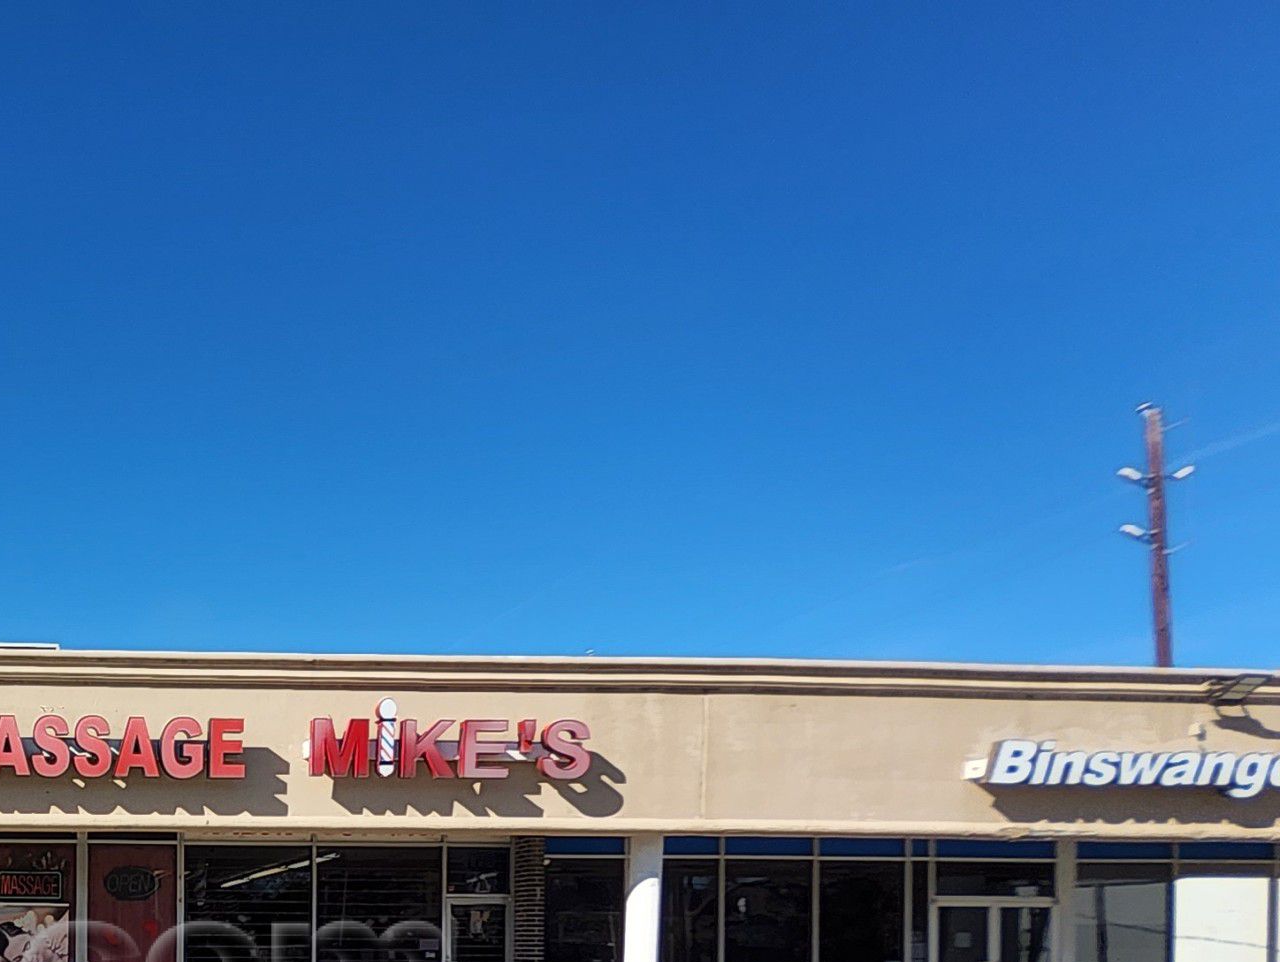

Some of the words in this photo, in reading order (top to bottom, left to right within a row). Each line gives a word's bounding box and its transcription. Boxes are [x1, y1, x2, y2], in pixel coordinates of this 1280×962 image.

[988, 738, 1280, 798] Binswang
[0, 874, 59, 896] MASSAGE
[106, 872, 151, 895] OPEN
